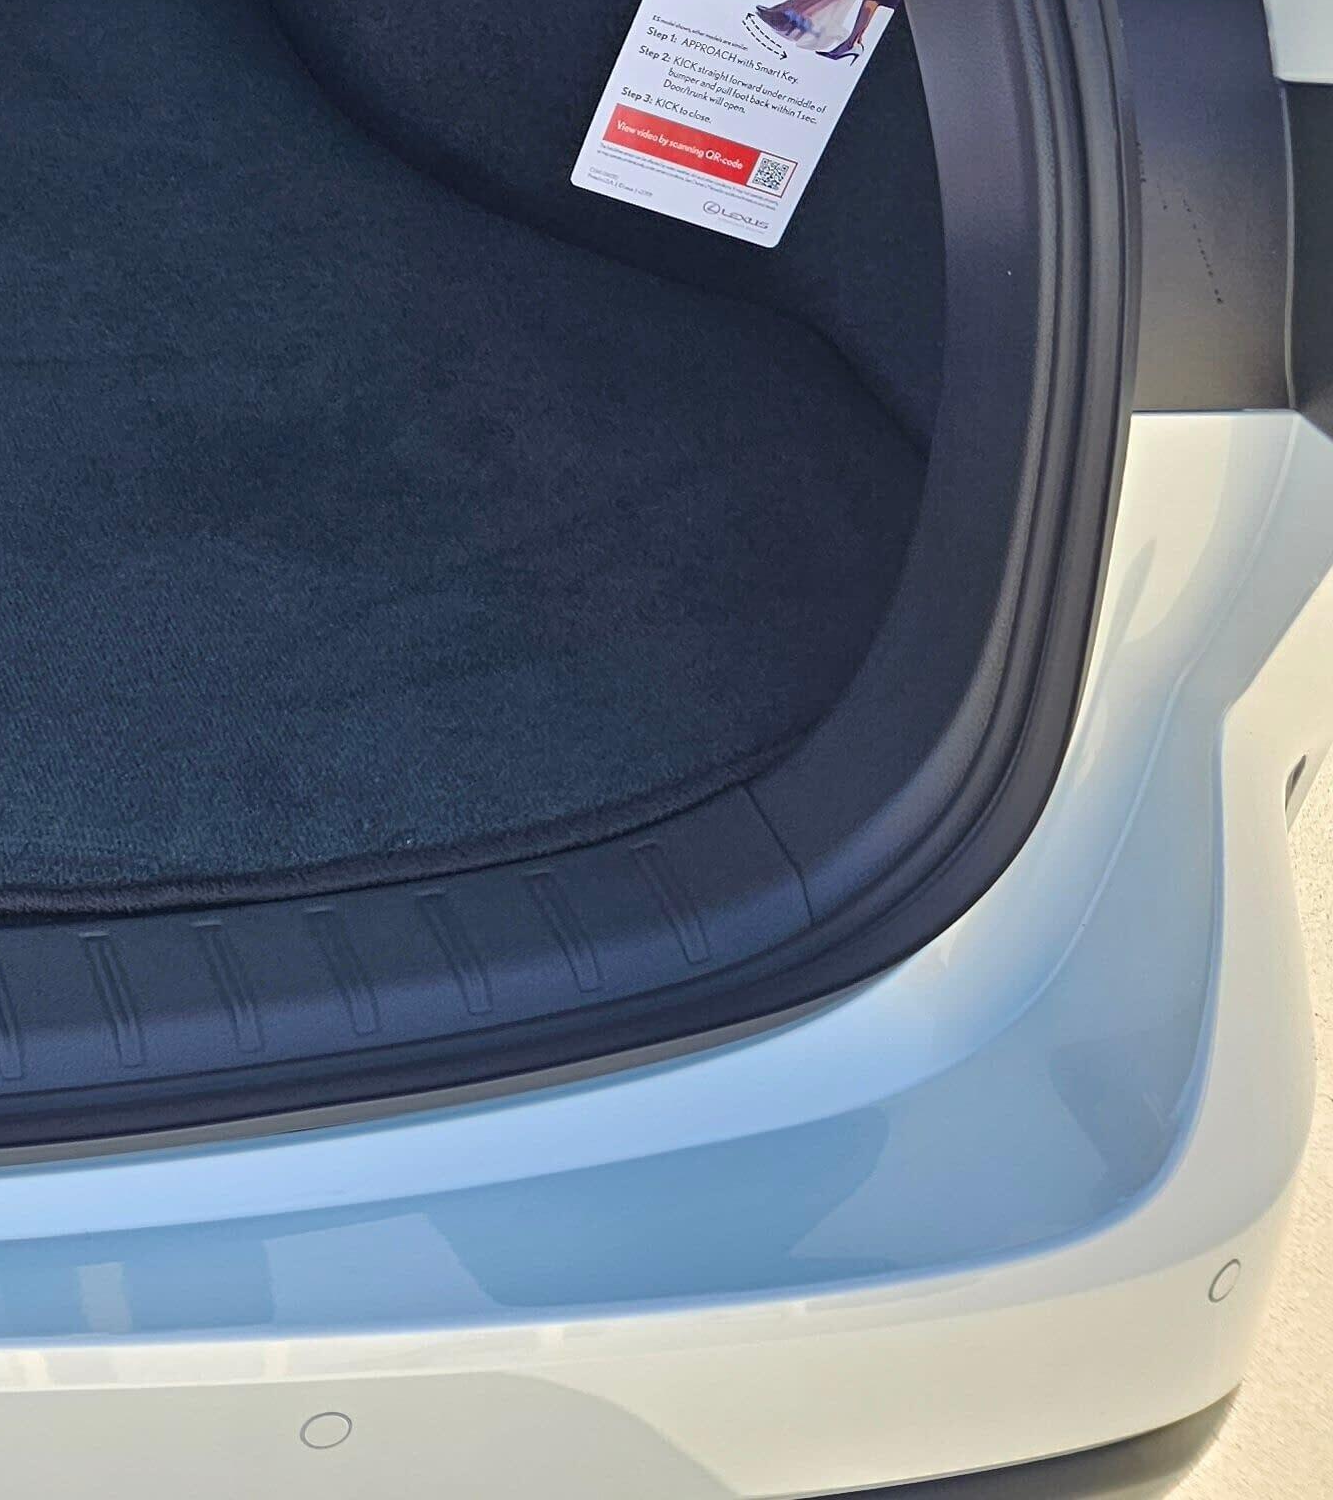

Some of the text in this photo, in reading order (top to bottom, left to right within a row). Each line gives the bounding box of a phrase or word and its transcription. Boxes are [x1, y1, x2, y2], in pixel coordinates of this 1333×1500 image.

[646, 26, 668, 41] Step
[669, 33, 677, 43] 1:
[681, 38, 738, 63] APPROACH
[737, 58, 754, 69] with
[754, 61, 781, 78] Smart
[638, 45, 827, 114] Step 2: KICK straight forward under middle of
[663, 79, 746, 114] Door/trunk will open.
[668, 67, 699, 84] bumper
[700, 81, 717, 91] and
[715, 86, 733, 96] pull
[732, 89, 750, 102] foot
[749, 95, 770, 109] back
[771, 104, 795, 117] within
[621, 86, 712, 124] Step 3: KICK to close.
[617, 120, 743, 170] View video by scanning QR-code
[721, 208, 770, 230] LEXUS
